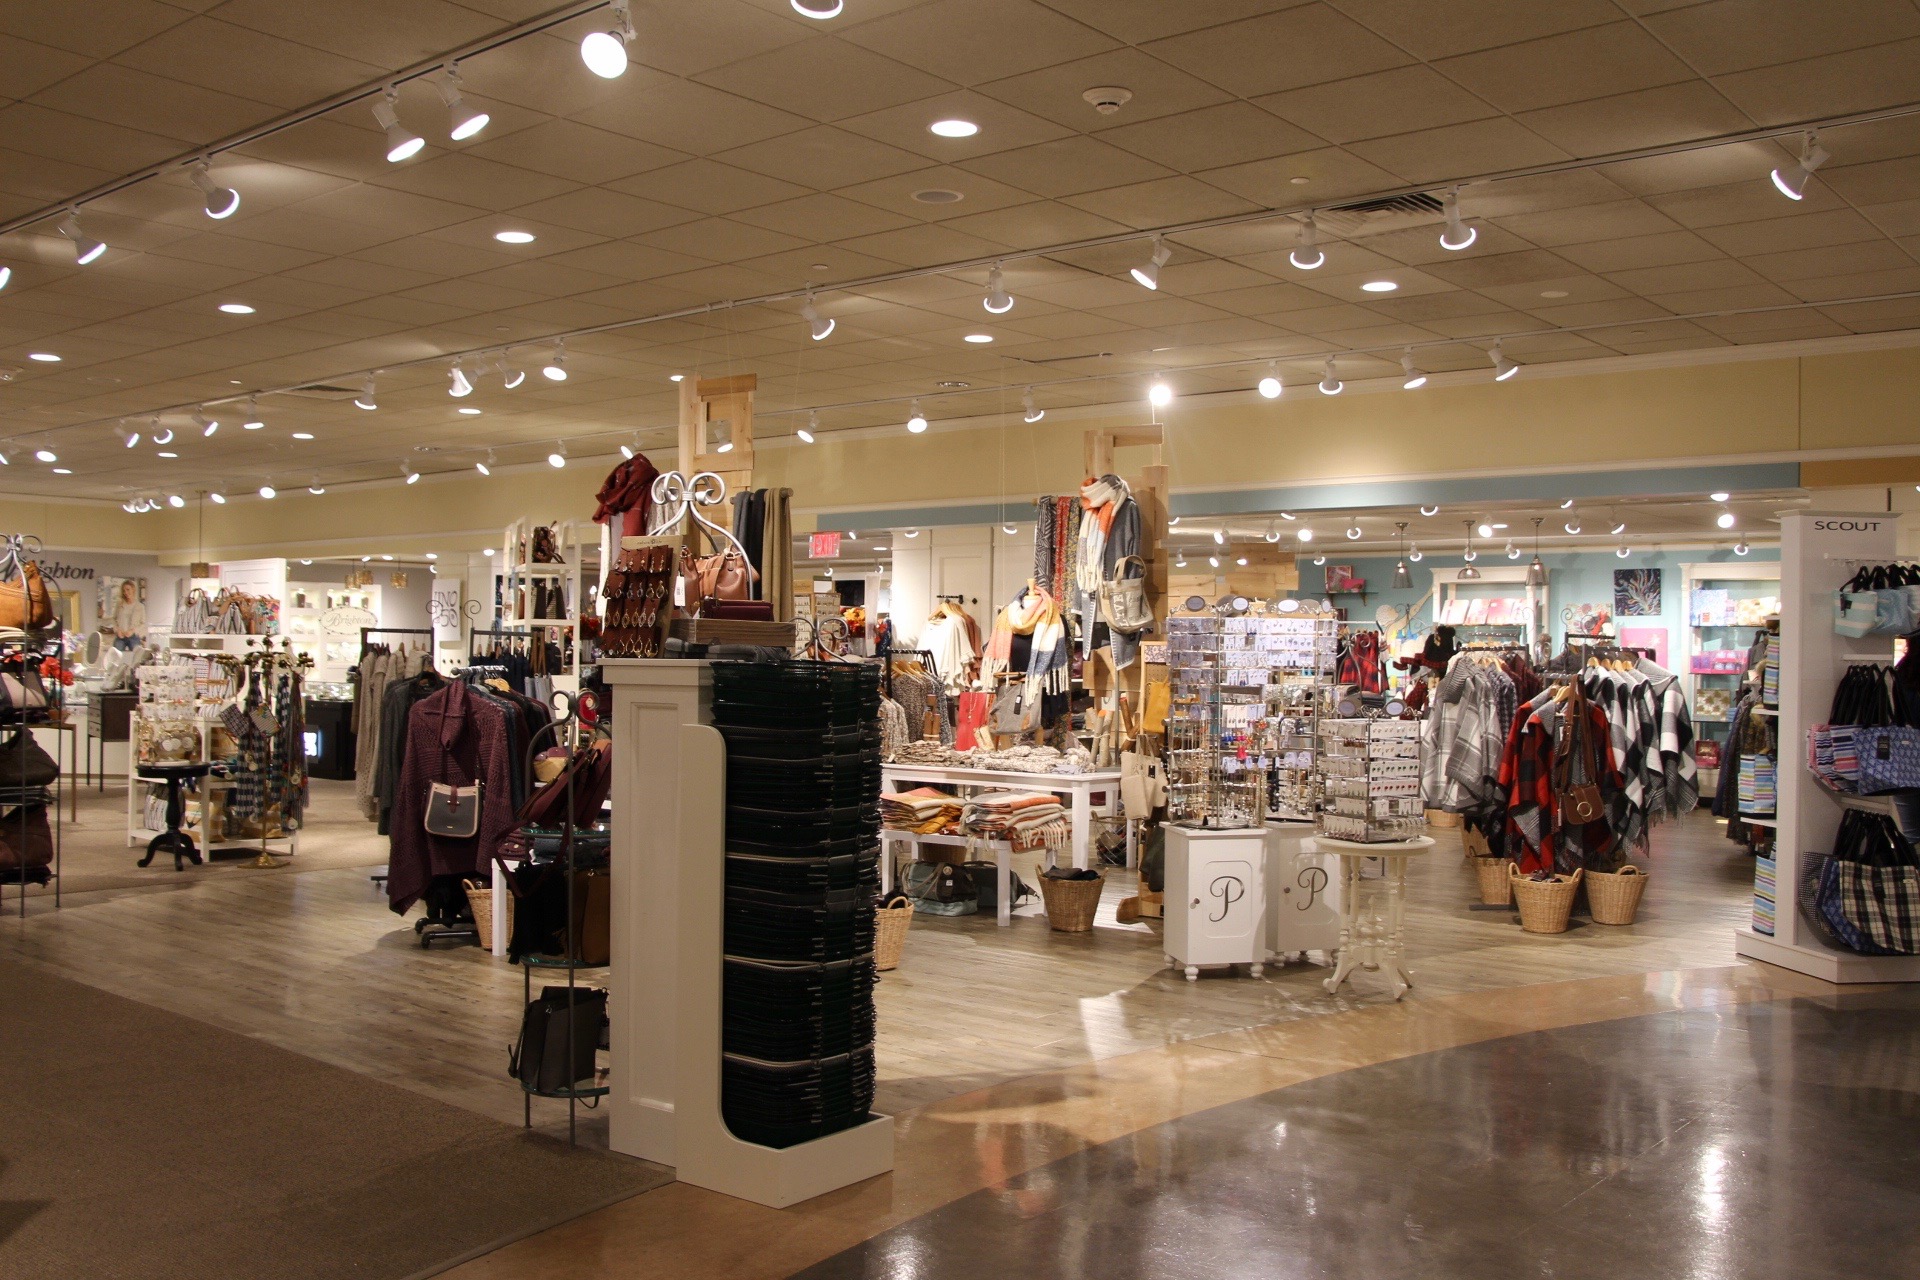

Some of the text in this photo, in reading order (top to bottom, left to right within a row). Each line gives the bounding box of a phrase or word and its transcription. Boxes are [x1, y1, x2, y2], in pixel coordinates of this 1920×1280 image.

[1814, 520, 1881, 532] SCOUT
[813, 533, 840, 556] EXIT
[1209, 875, 1245, 922] P
[1296, 866, 1329, 911] P
